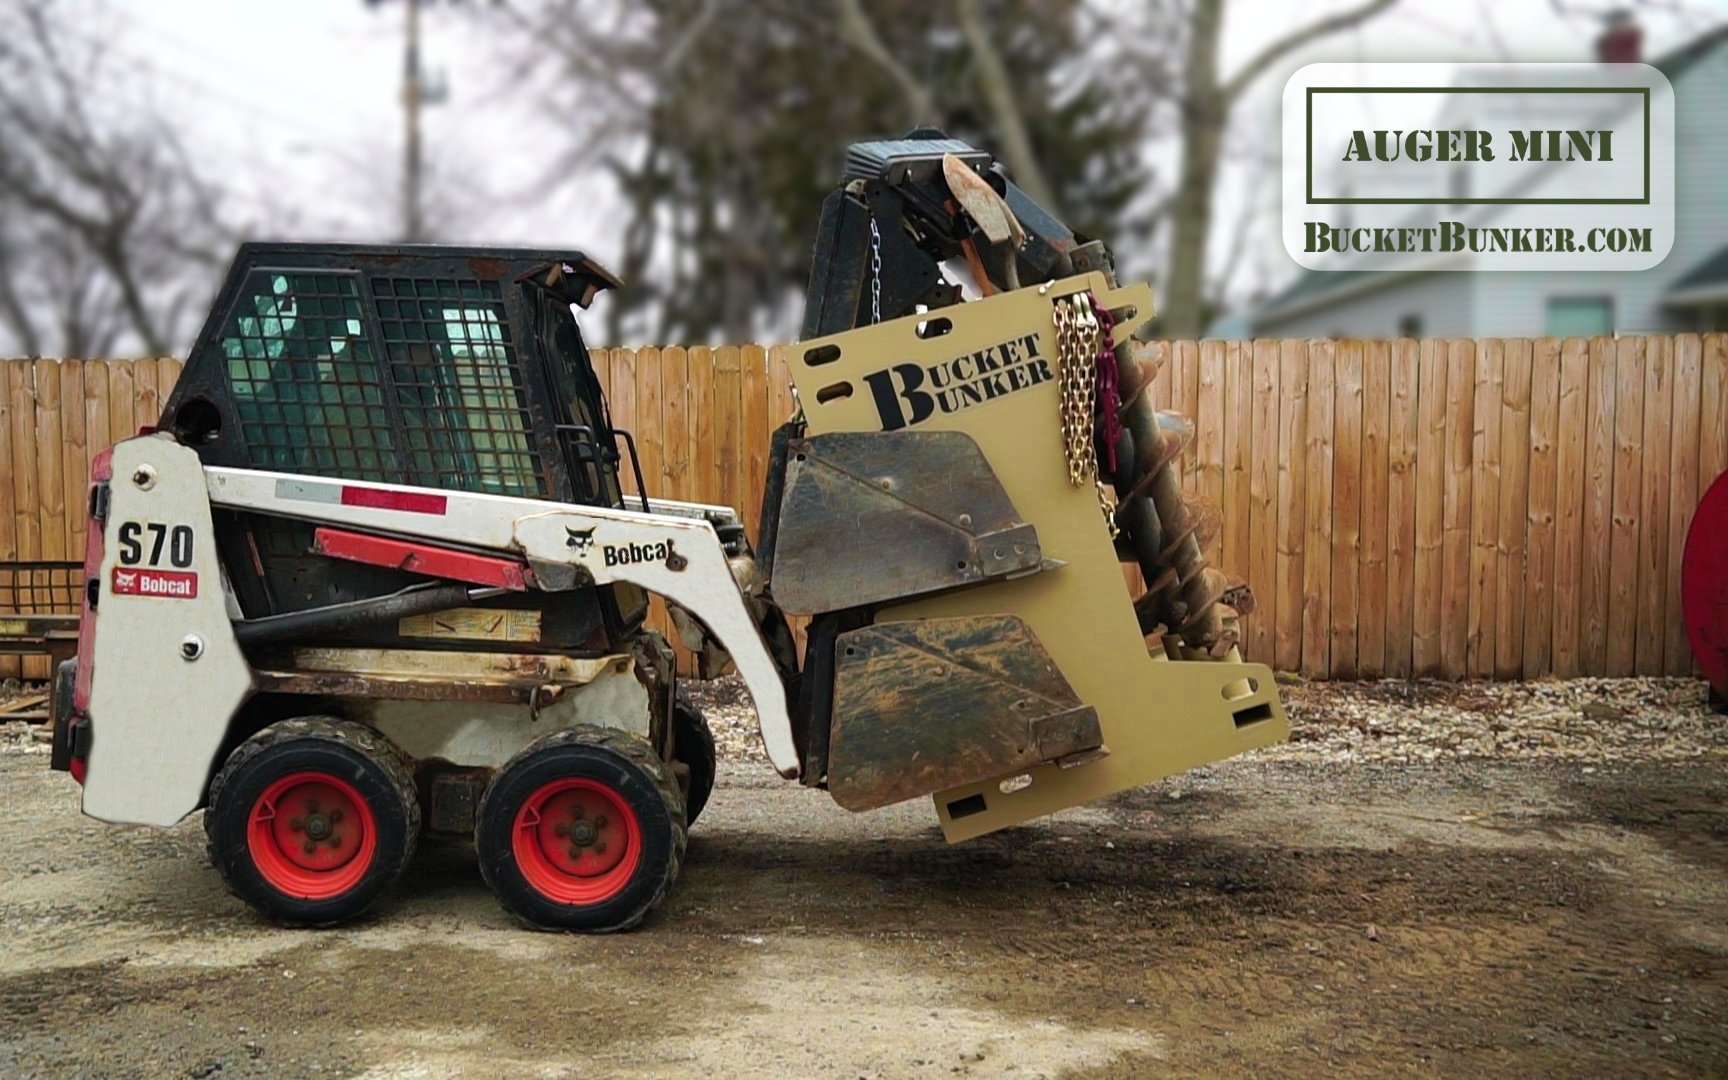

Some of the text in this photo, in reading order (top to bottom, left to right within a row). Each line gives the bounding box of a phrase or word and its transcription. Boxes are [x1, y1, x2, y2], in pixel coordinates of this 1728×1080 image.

[119, 522, 193, 568] S70
[603, 538, 673, 567] Bobca
[140, 576, 191, 595] Bobcat
